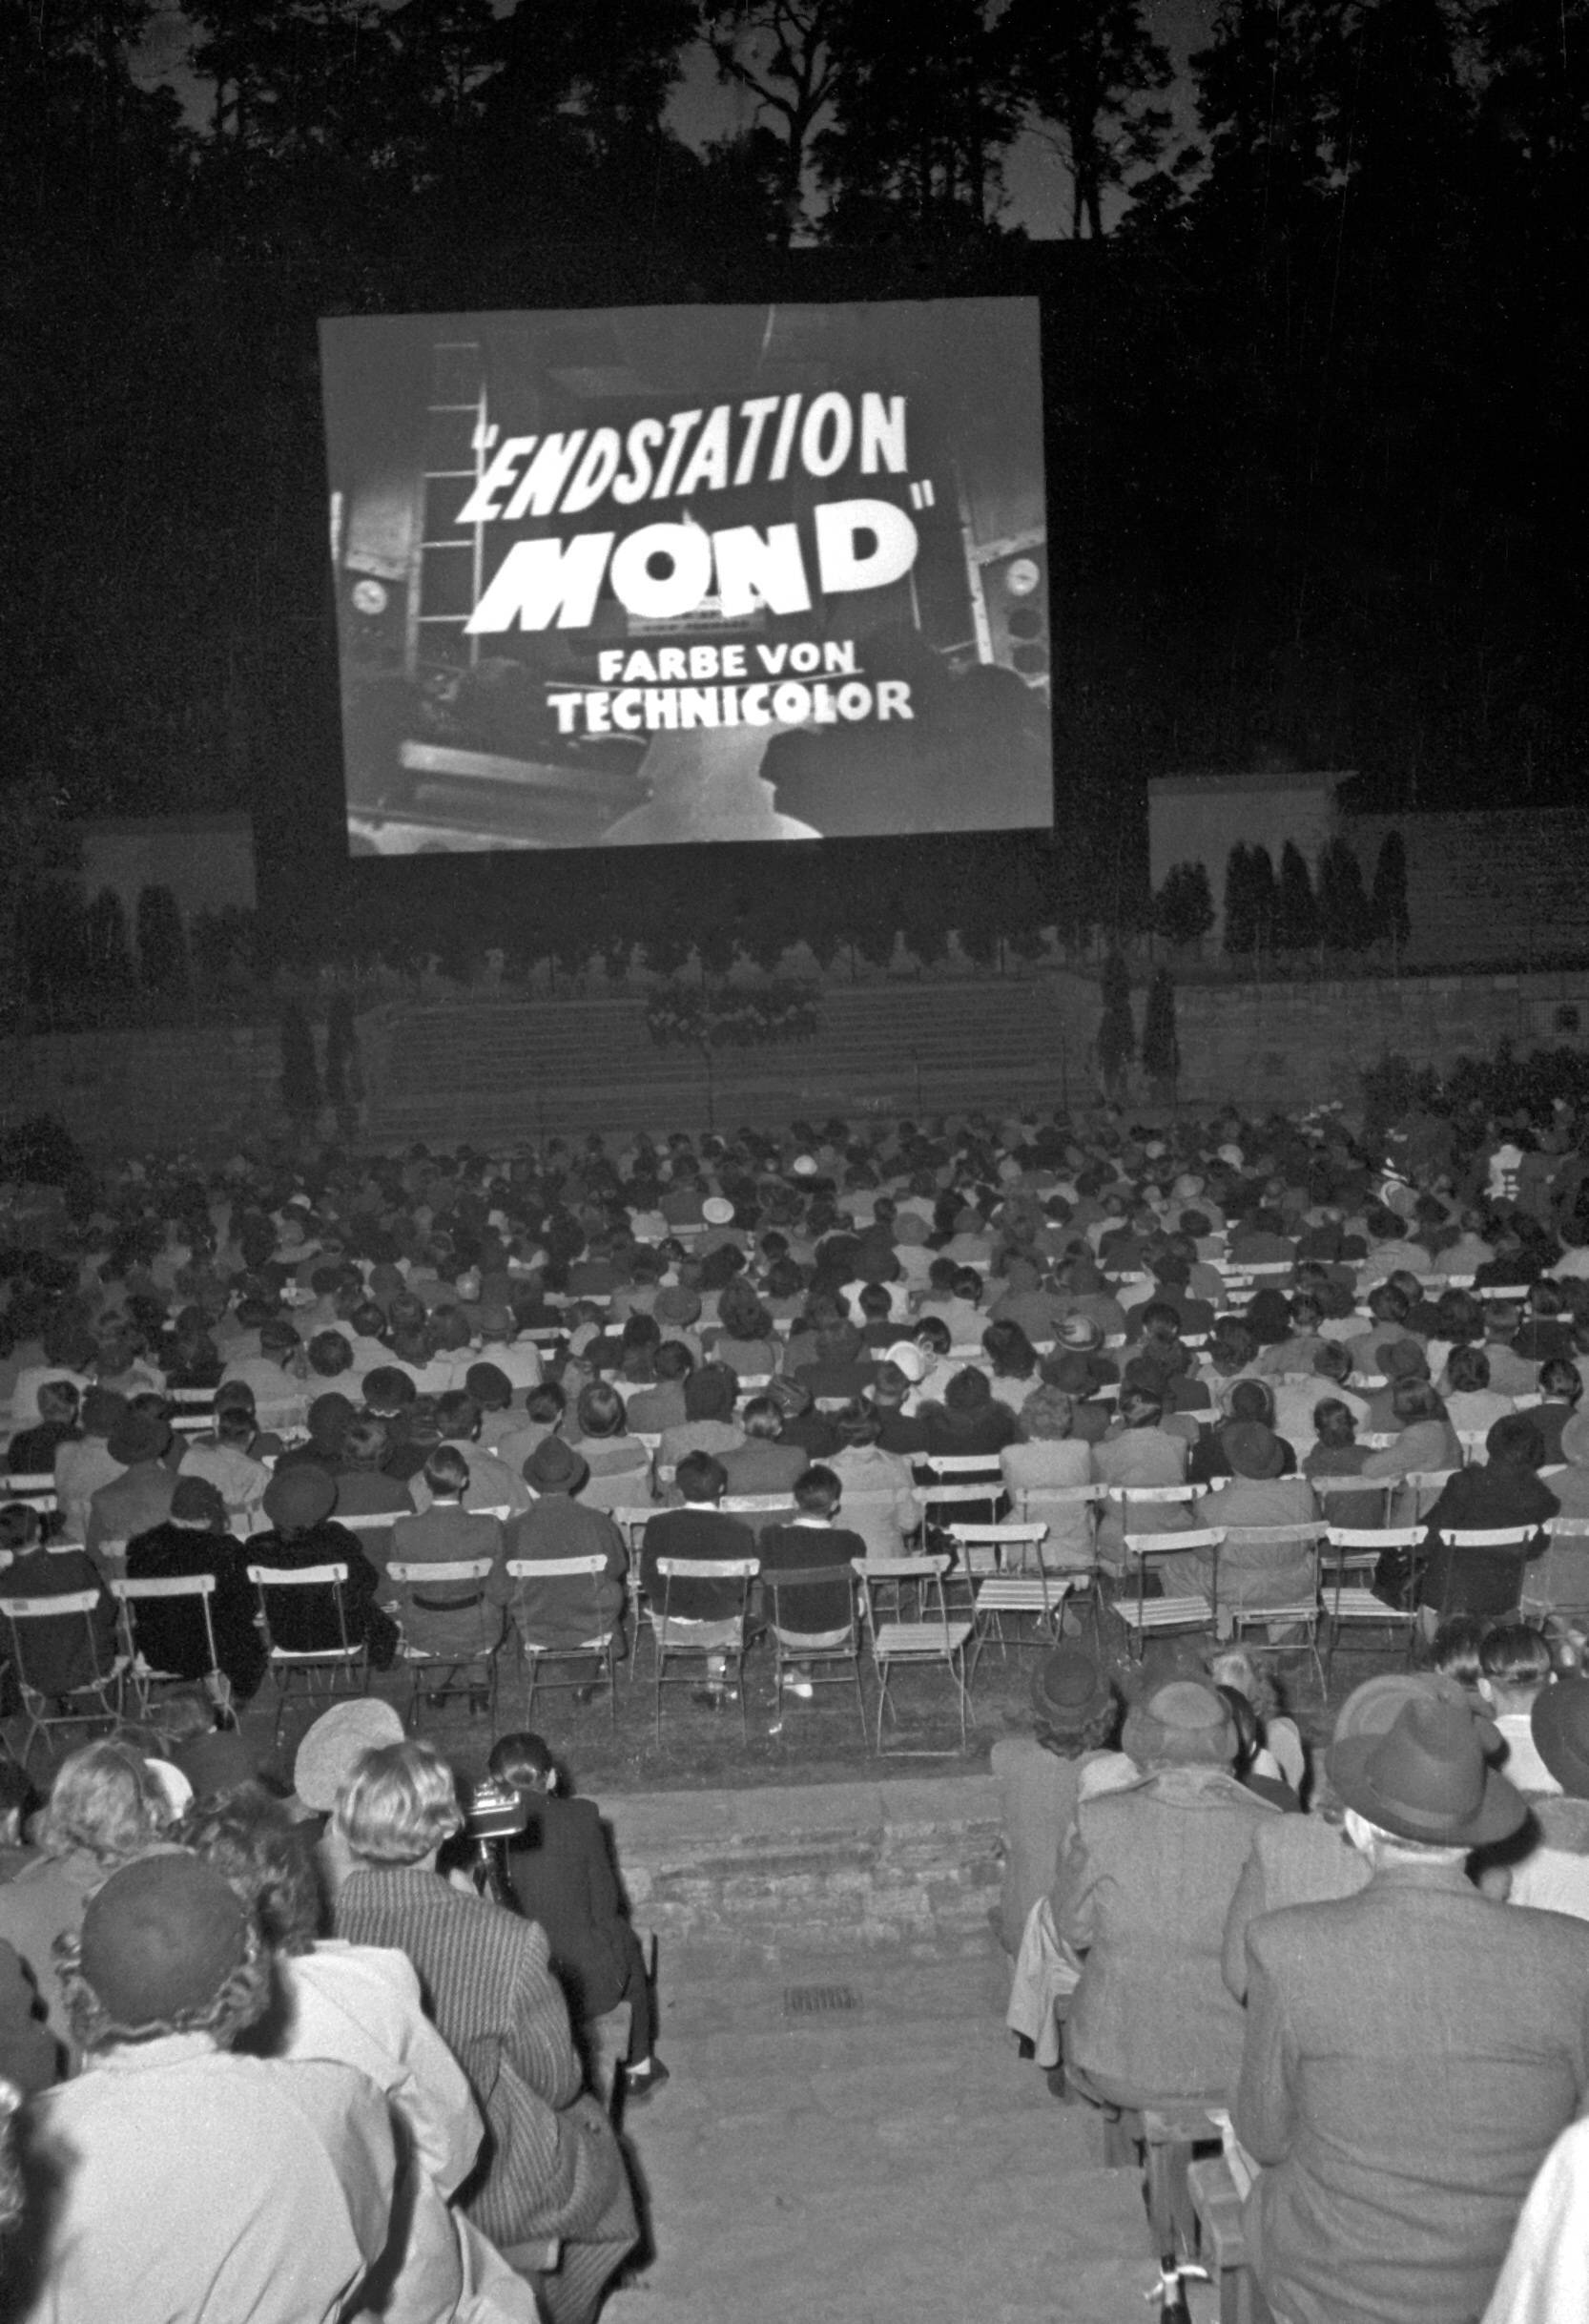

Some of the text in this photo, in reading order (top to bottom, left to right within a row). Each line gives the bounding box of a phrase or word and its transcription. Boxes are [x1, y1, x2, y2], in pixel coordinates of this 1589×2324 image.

[455, 391, 908, 524] "ENDSTATION
[462, 479, 936, 634] MOND"
[547, 680, 915, 733] TECHNICOLOR
[598, 639, 856, 682] FARBE VON
